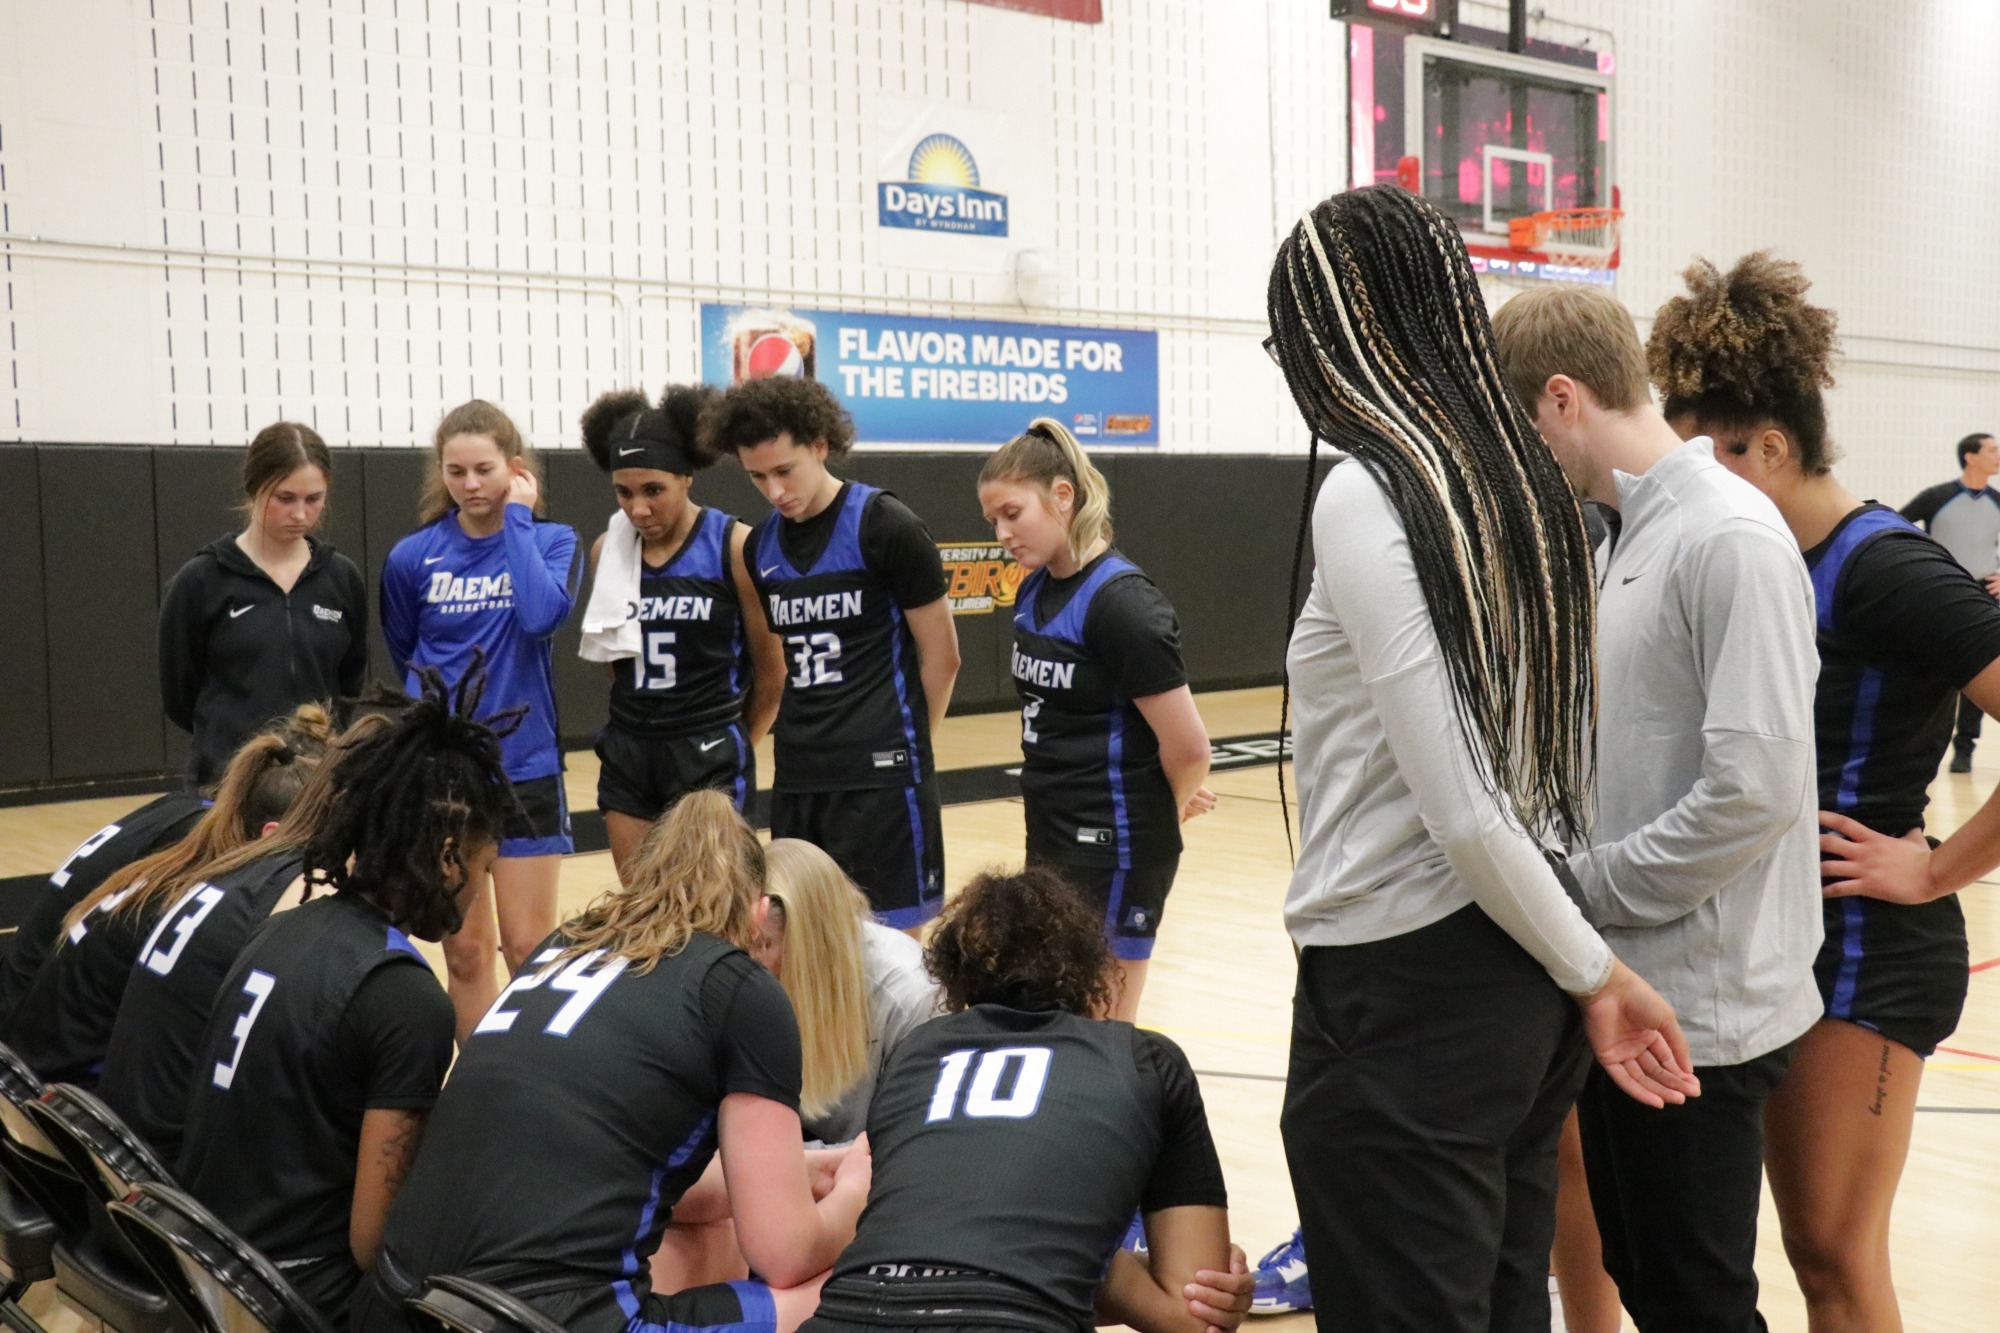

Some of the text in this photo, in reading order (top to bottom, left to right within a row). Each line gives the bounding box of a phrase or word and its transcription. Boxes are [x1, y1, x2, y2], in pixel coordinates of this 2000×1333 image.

[886, 184, 1003, 221] Days Inn
[915, 219, 976, 231] BY WYNDHAM
[838, 327, 1123, 372] FLAVOR MADE FOR
[838, 365, 1068, 404] THE FIREBIRDS
[939, 547, 987, 562] VERSITY
[427, 571, 513, 604] DAEME
[441, 599, 515, 614] BASKETBAL
[640, 596, 713, 621] EMEN
[768, 590, 862, 626] DAEMEN
[787, 632, 843, 688] 32
[138, 882, 226, 976] 13
[472, 947, 633, 1038] 24
[212, 968, 277, 1091] 3
[925, 1046, 1054, 1124] 10
